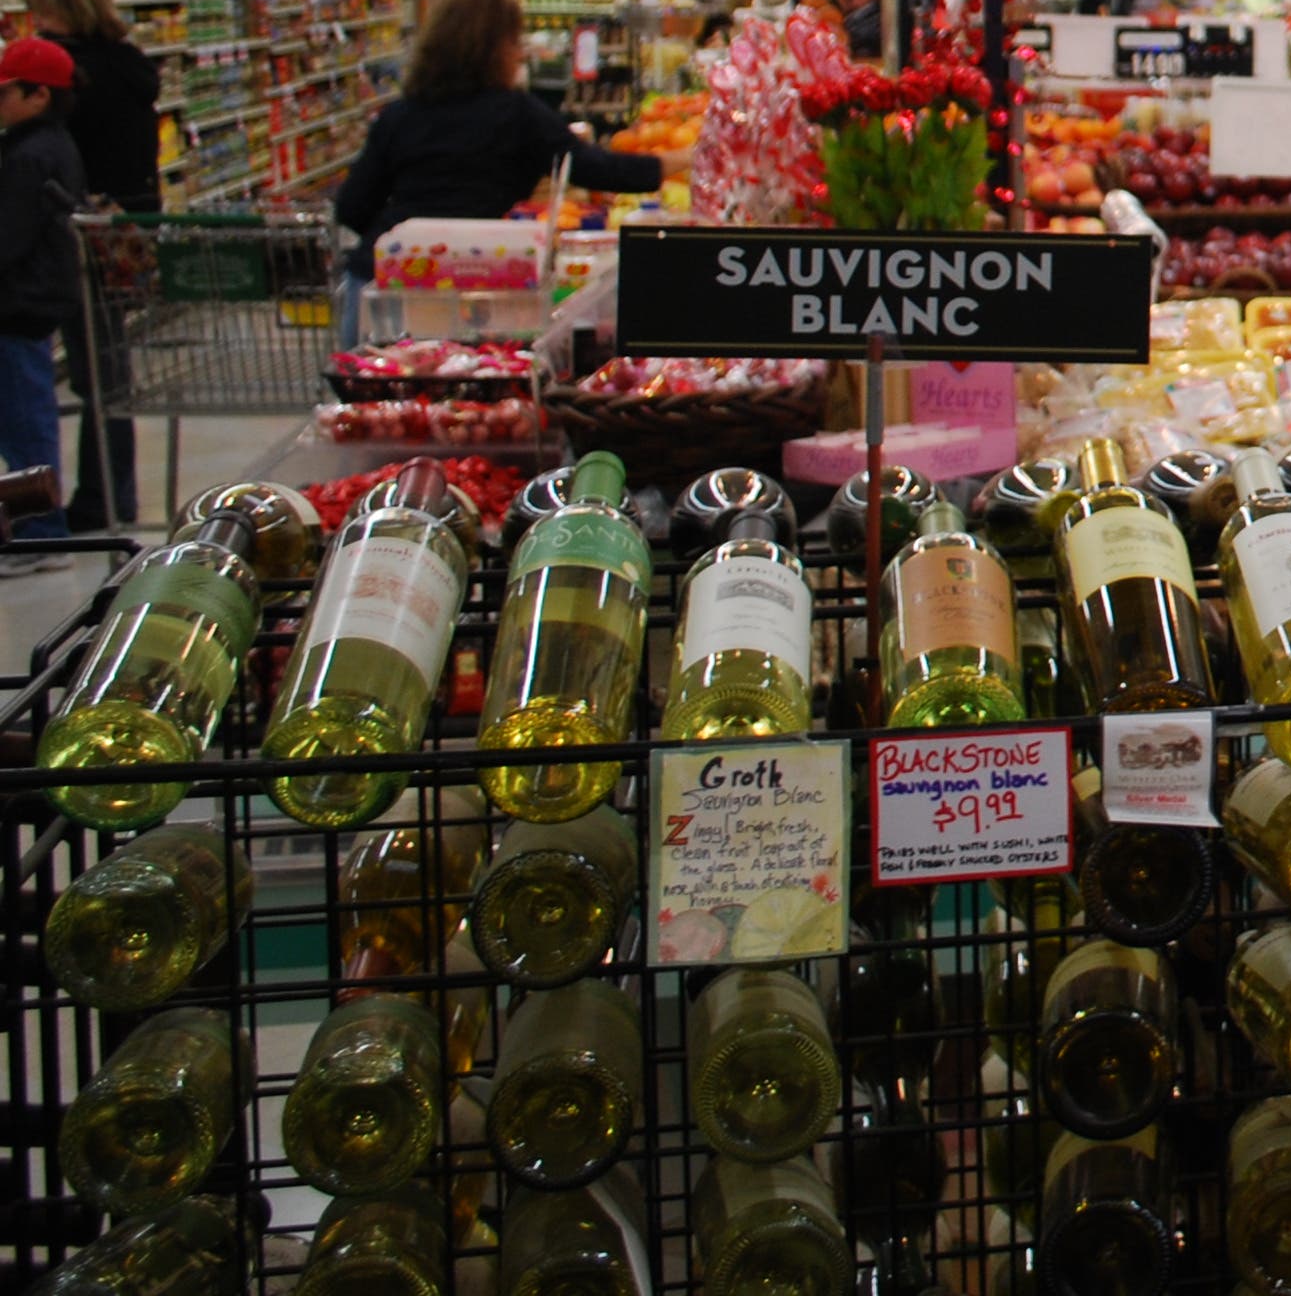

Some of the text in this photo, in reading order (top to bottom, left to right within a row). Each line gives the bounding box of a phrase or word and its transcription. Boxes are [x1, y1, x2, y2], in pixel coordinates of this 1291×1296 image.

[716, 246, 1053, 292] SAUVIGNON
[790, 295, 981, 337] BLANC
[919, 378, 1002, 410] Hearts
[700, 755, 784, 790] Groth
[879, 740, 1043, 782] BLACKSTONE
[774, 785, 825, 806] Blanc
[991, 769, 1049, 790] blanc
[932, 790, 1024, 835] $9.99
[919, 842, 955, 856] WELL
[957, 840, 988, 852] WITH
[1007, 850, 1059, 864] OYSTERS
